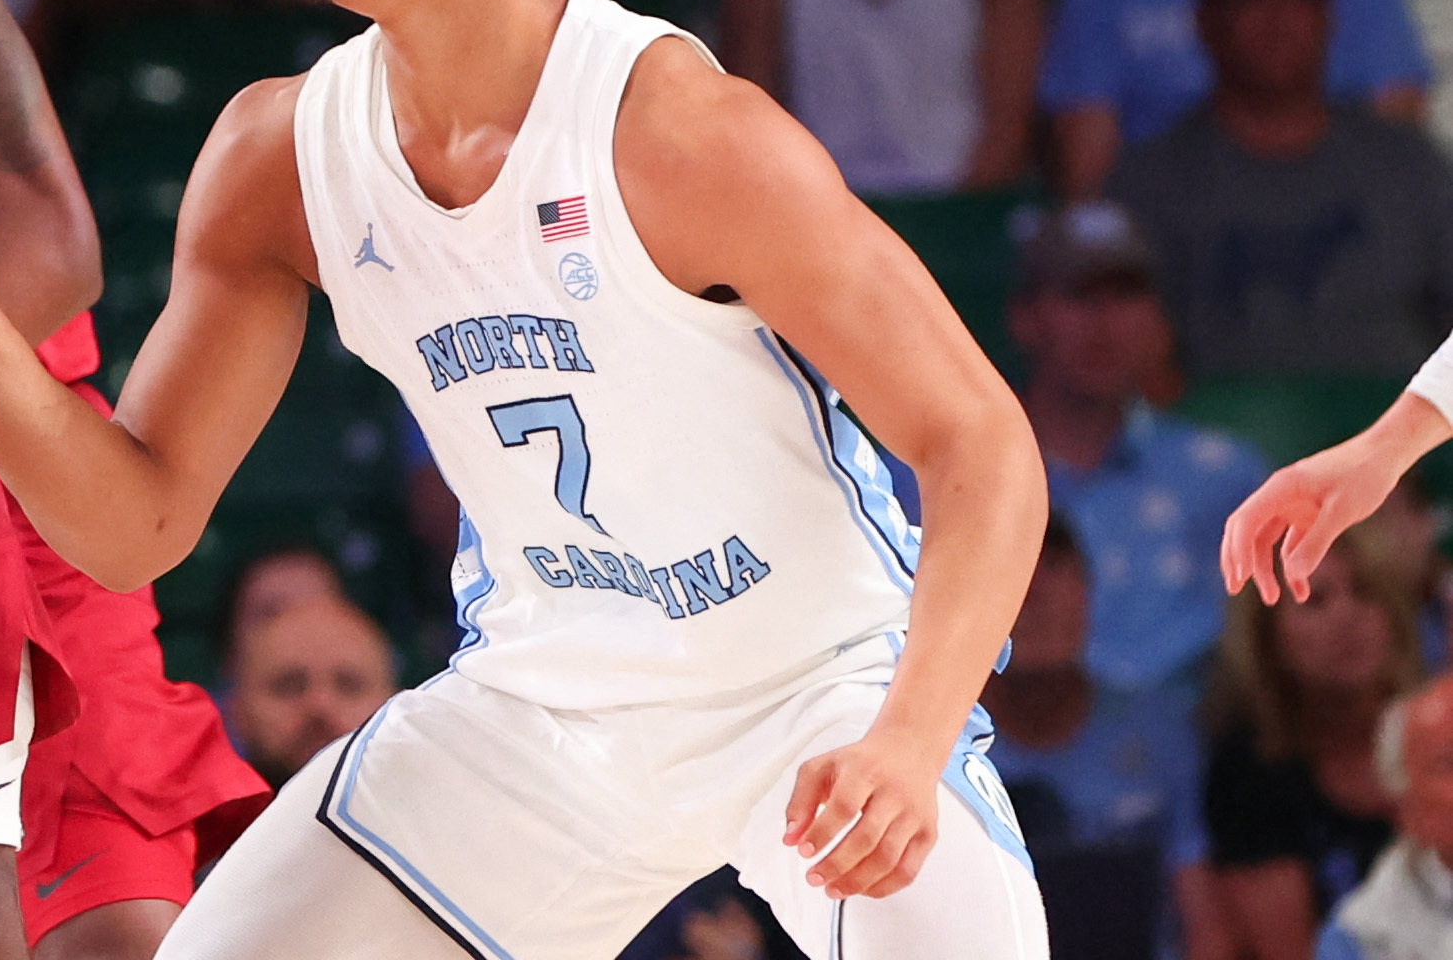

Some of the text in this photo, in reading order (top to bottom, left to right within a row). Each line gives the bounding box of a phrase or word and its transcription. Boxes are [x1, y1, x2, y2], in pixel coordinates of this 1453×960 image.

[416, 313, 596, 393] NORTH
[485, 392, 614, 540] 7
[522, 534, 772, 620] CAROINA
